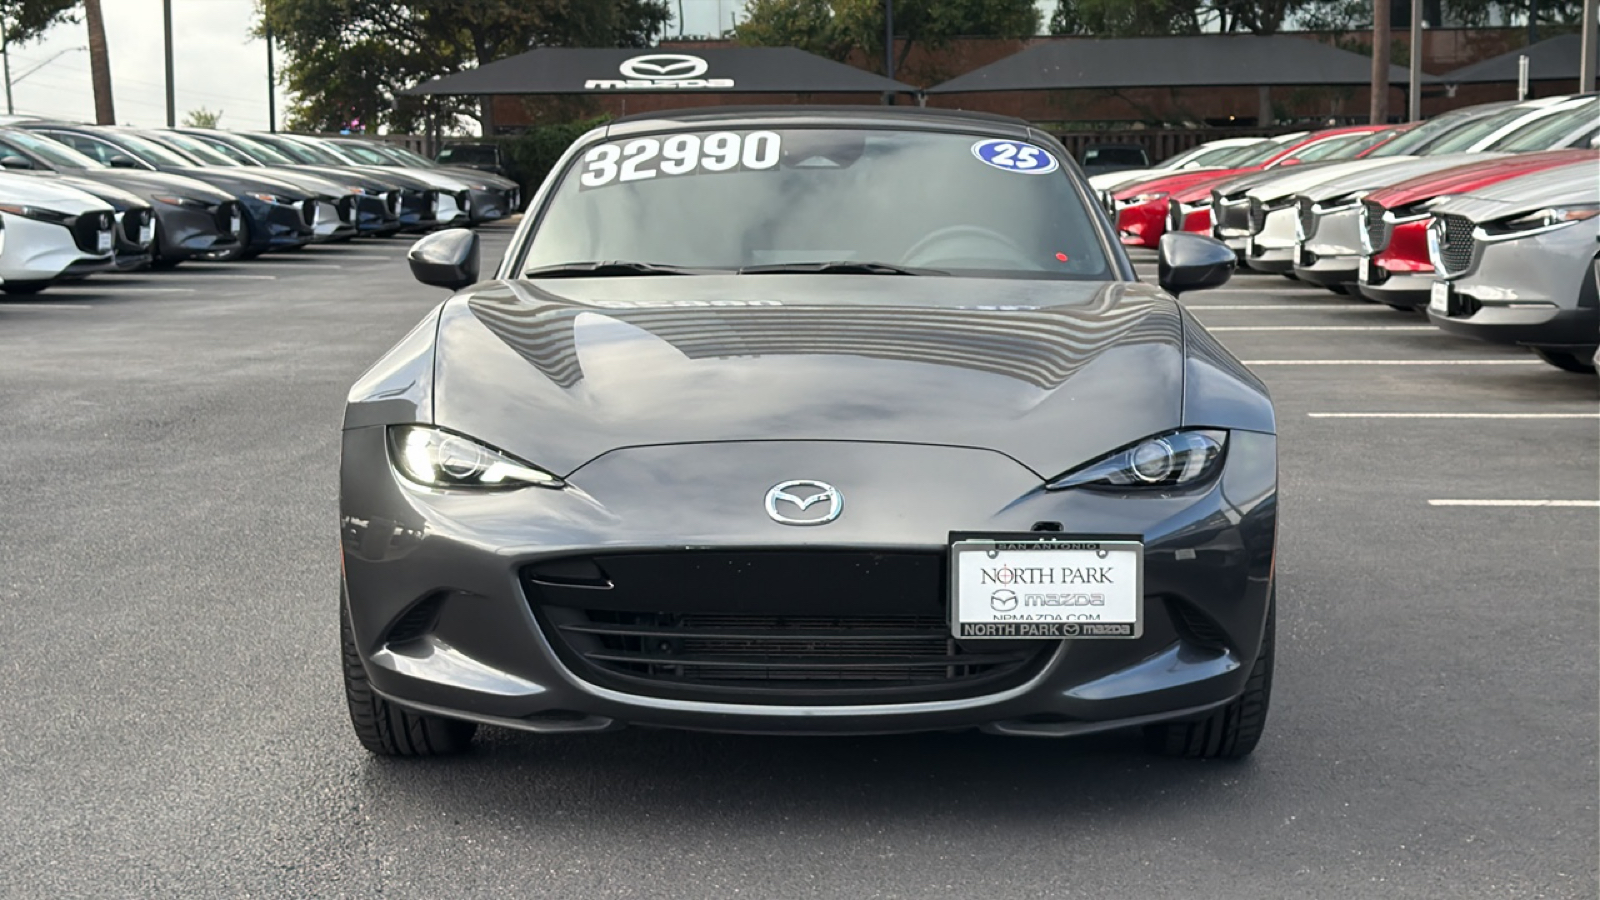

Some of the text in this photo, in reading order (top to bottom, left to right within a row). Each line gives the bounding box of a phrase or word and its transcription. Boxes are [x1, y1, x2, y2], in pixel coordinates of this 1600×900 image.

[580, 130, 781, 187] 32990
[991, 143, 1039, 169] 25
[981, 567, 1114, 585] NORTH PARK
[1024, 593, 1105, 606] mazda
[964, 624, 1131, 636] NORTH PARK mazda
